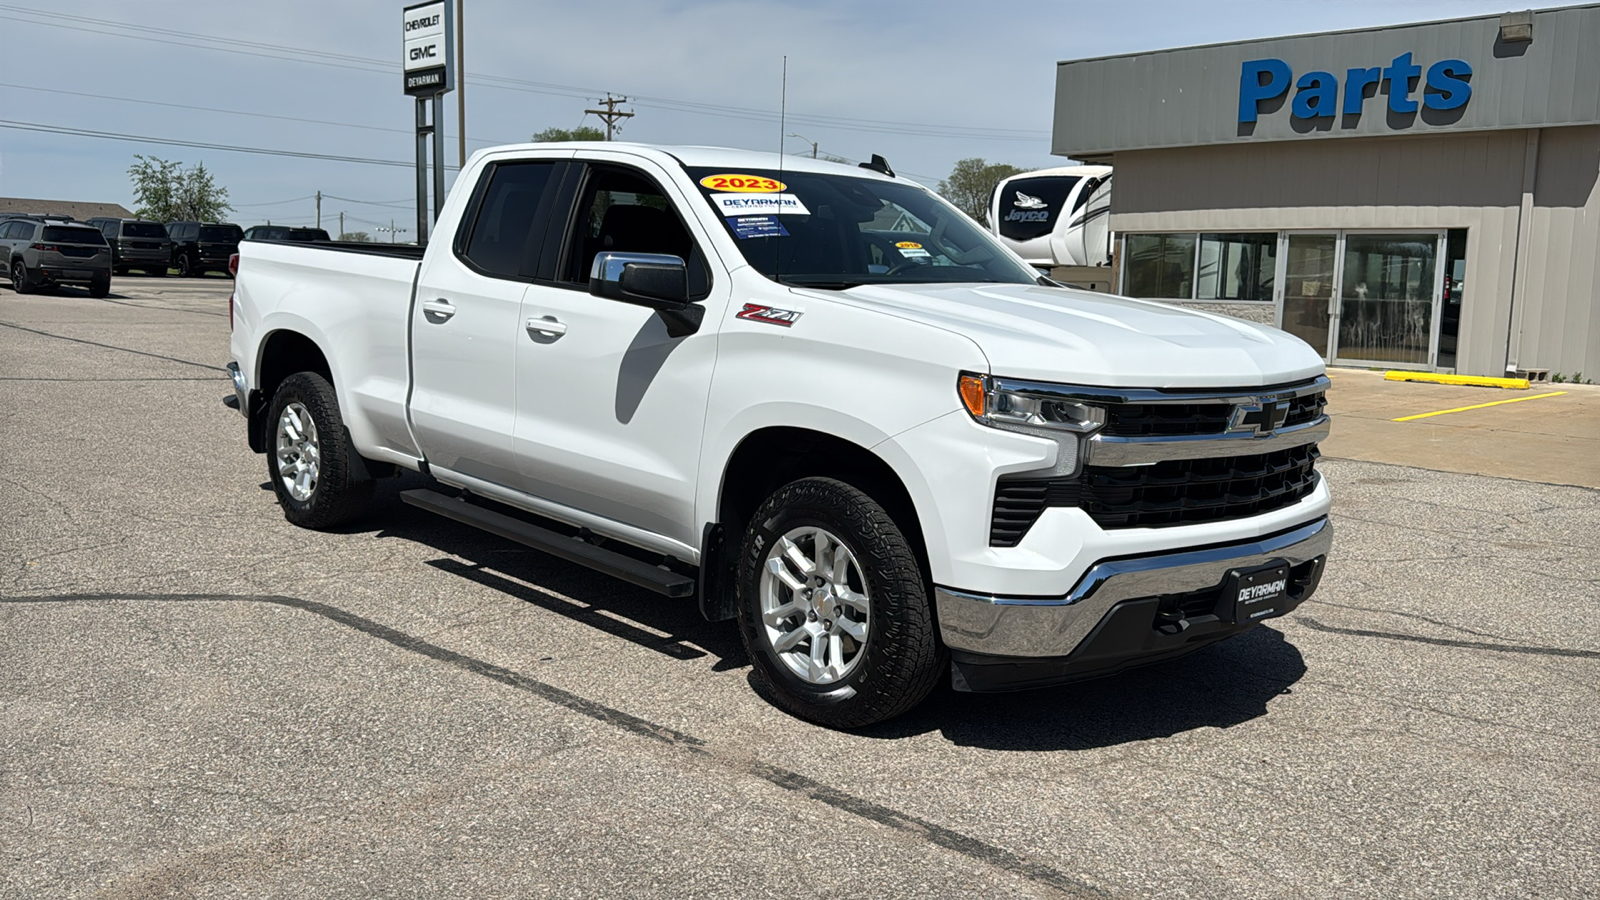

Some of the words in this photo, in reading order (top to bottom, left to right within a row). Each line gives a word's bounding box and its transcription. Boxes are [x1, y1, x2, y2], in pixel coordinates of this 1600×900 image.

[405, 14, 440, 32] CHEVROLET
[410, 44, 436, 61] GMC
[408, 74, 440, 87] DEYARMAN
[1238, 52, 1474, 123] Parts
[712, 178, 778, 190] 2023
[723, 199, 797, 207] DEYARMAN
[1004, 209, 1049, 223] Jayco
[735, 303, 804, 328] Z71
[1238, 579, 1287, 602] DEYARMAN
